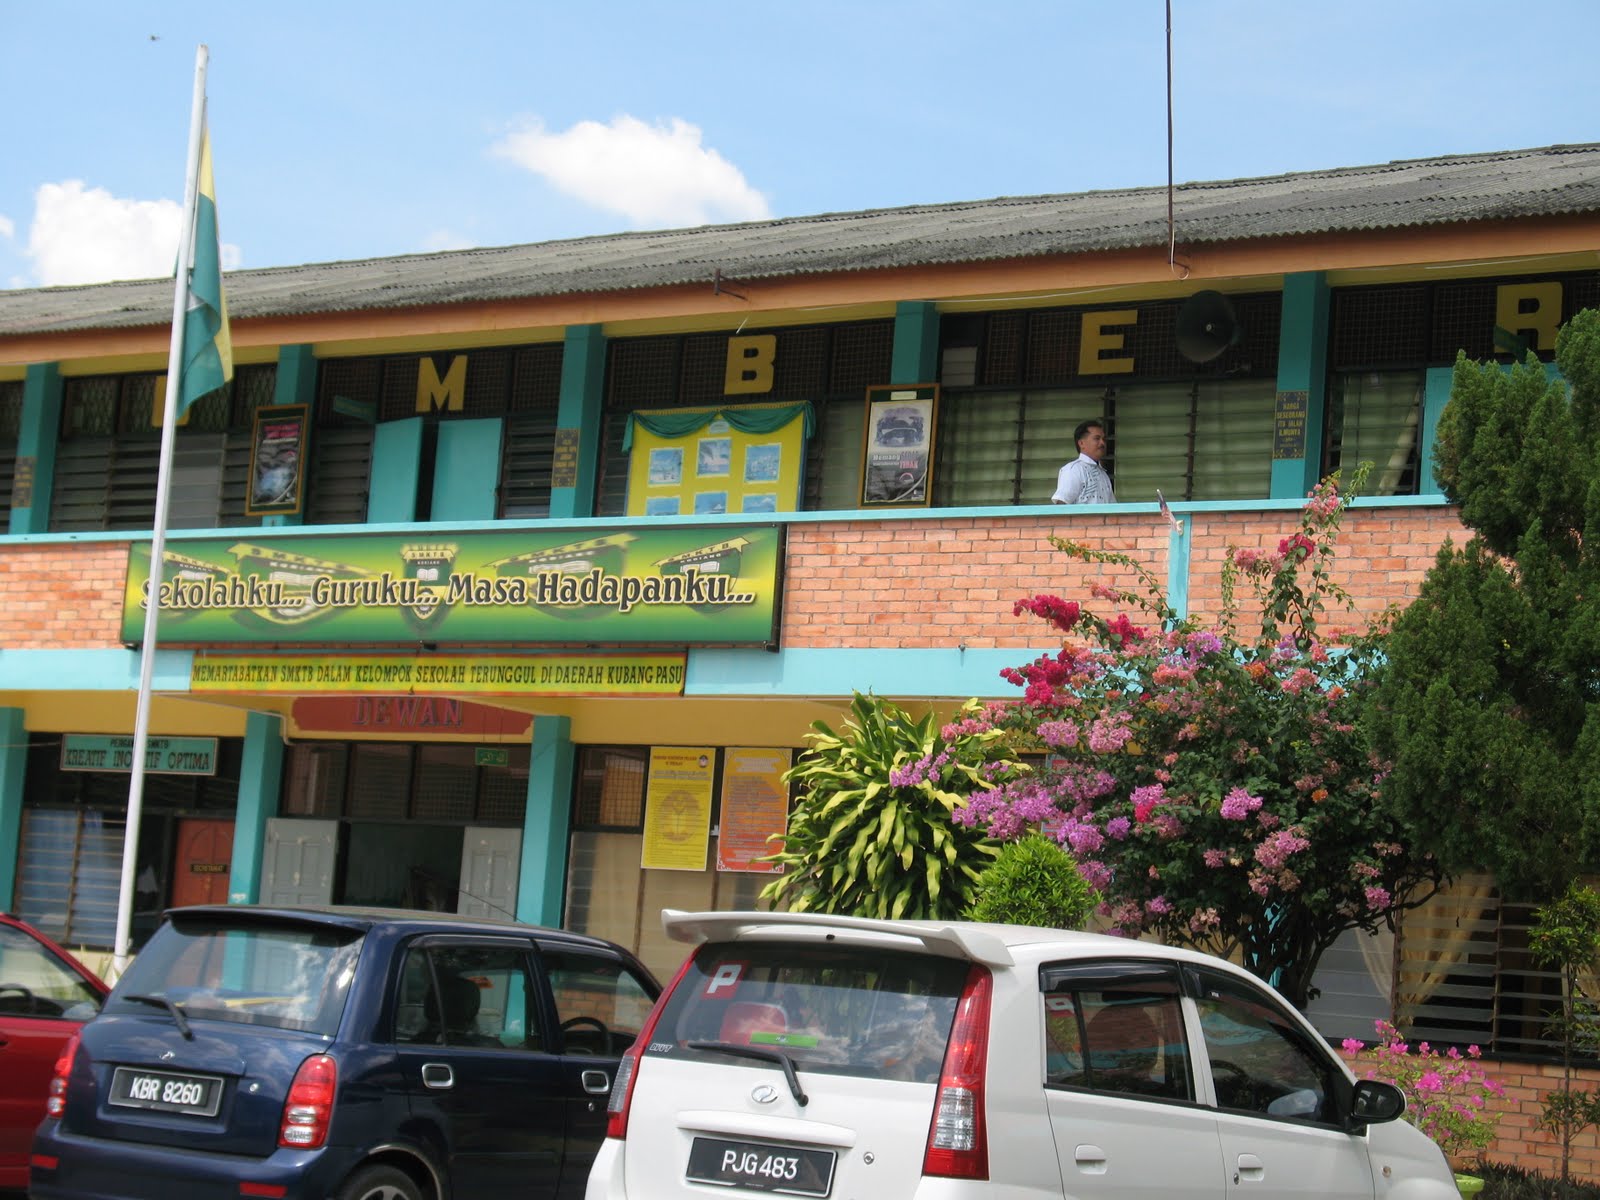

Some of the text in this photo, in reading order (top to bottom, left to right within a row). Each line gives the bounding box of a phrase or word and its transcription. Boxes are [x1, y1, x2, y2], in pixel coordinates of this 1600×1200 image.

[415, 355, 468, 412] M
[724, 334, 777, 395] B
[1078, 309, 1138, 375] E
[310, 571, 440, 608] Guruku...
[448, 568, 528, 606] Masa
[535, 564, 756, 613] Hadapanku...
[192, 664, 684, 685] MEMARTABATKAN SMKTB DALAM KELOMPOK SEKOLAH TERUNGGUL DI DAERAH KUBANG PASU
[352, 696, 463, 727] DEWAN
[65, 750, 210, 770] KREATIF INOTIF OPTIMA
[129, 1077, 203, 1105] KBR 8260
[721, 1150, 799, 1180] PJG 483
